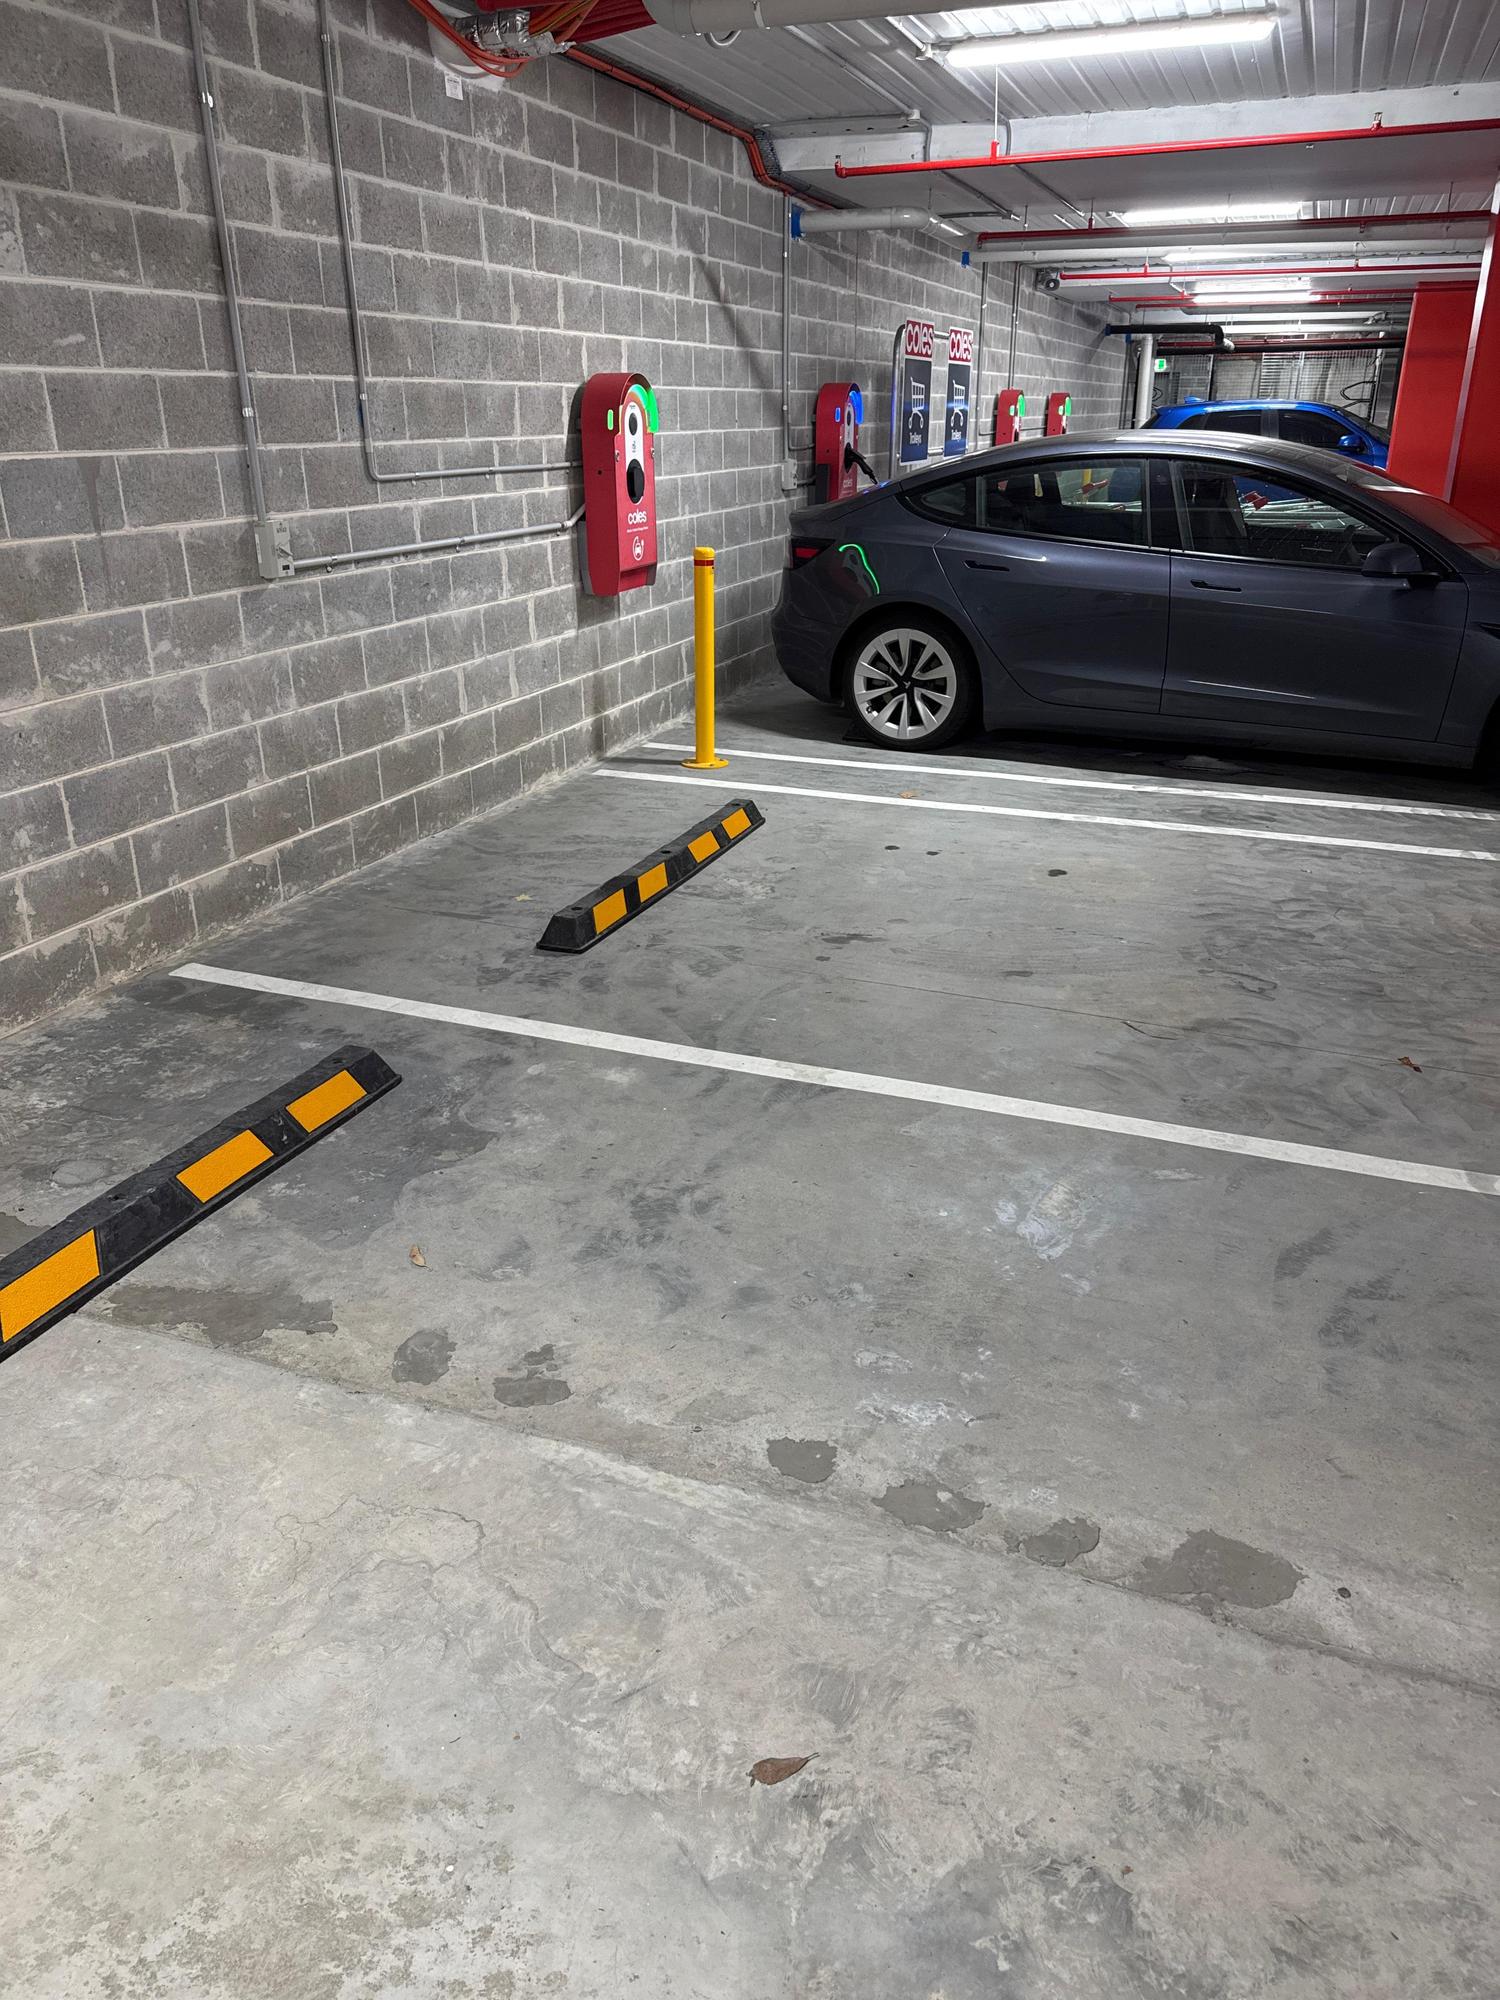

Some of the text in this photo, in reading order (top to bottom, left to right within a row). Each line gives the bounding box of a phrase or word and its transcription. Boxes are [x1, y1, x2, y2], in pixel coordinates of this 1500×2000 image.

[906, 322, 934, 355] coles
[949, 330, 973, 360] coles
[628, 509, 647, 525] coles
